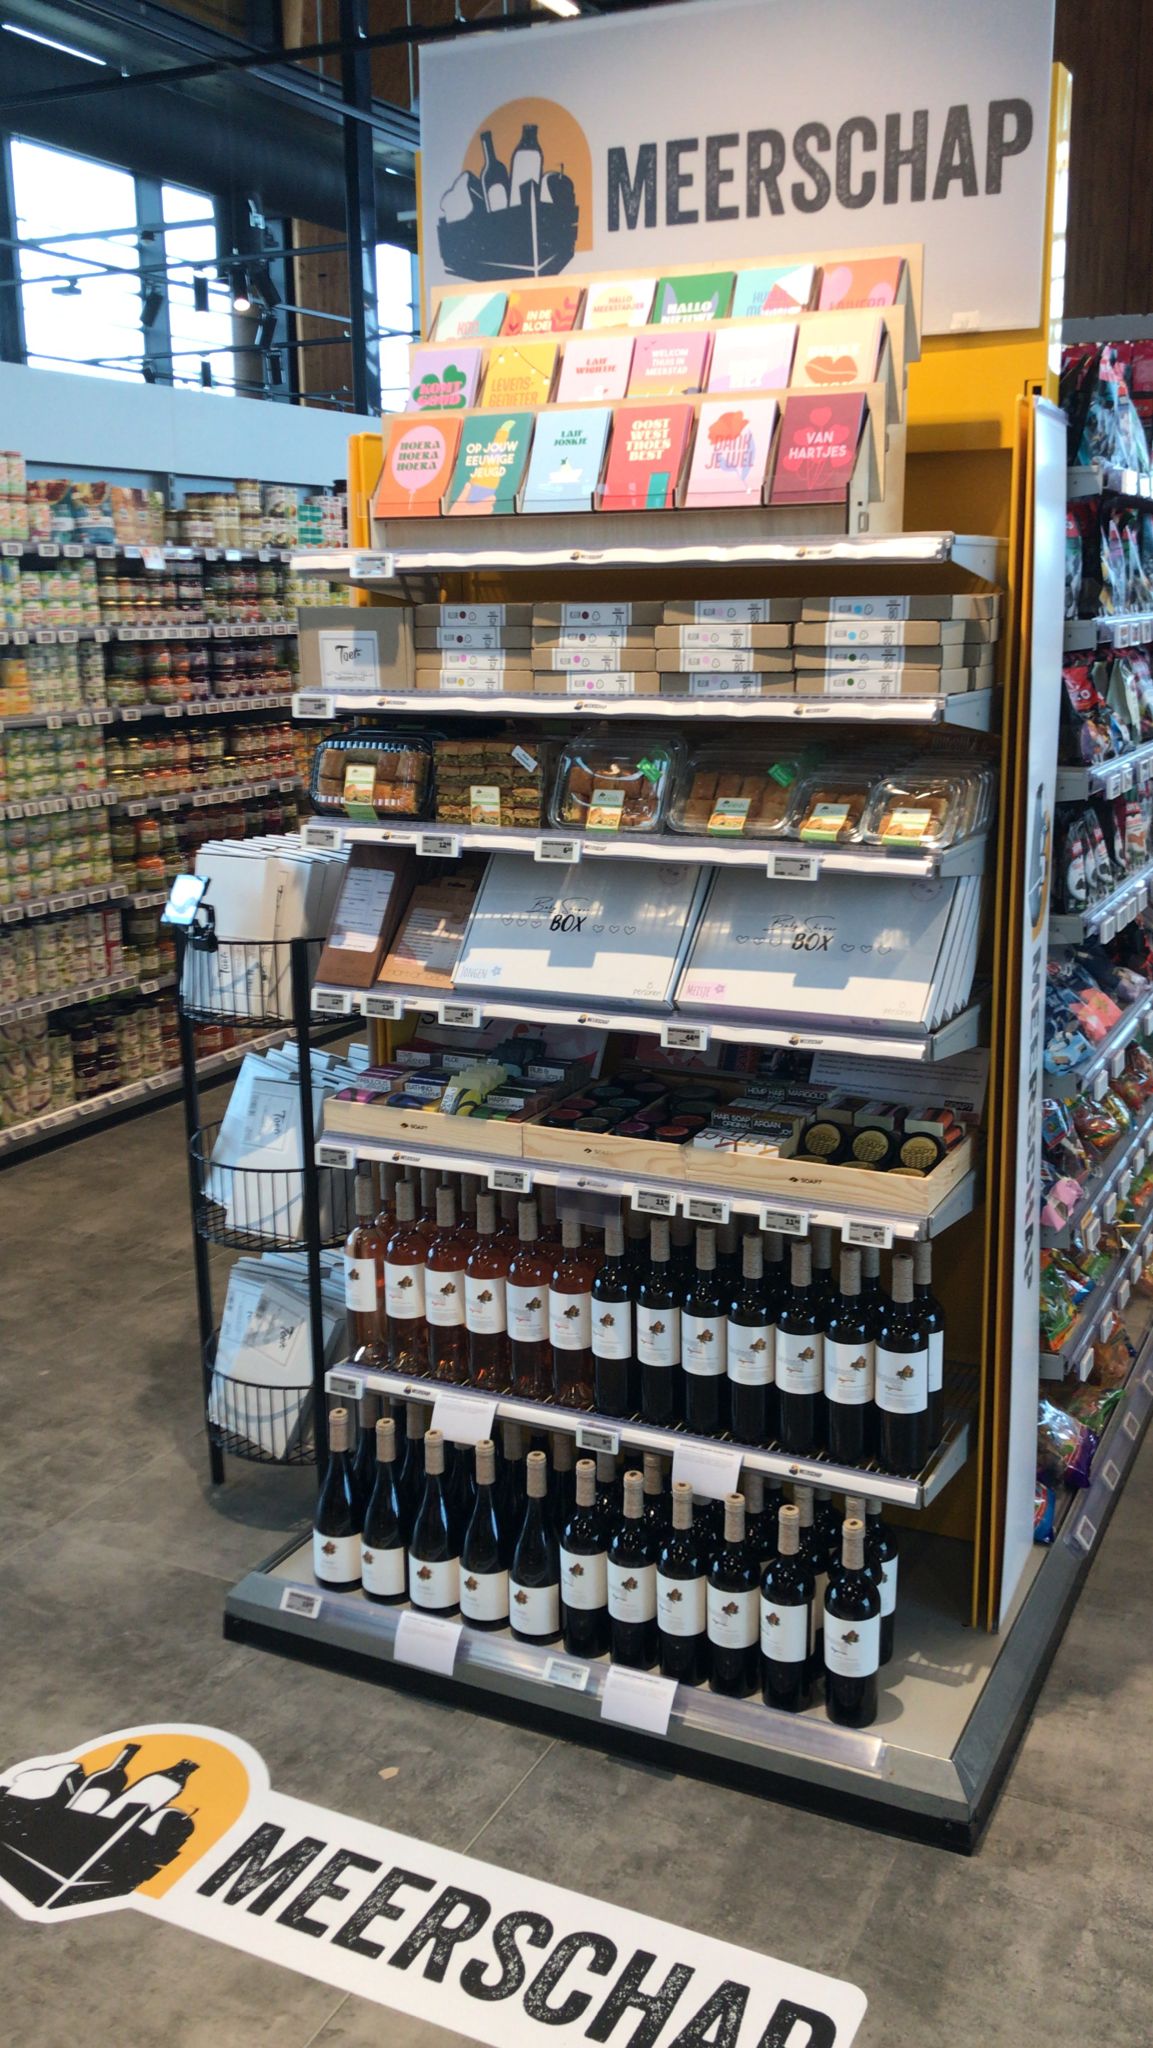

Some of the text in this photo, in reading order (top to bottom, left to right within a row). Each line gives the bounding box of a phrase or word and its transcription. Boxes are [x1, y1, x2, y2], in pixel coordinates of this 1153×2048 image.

[607, 98, 1033, 232] MEERSCHAP
[666, 300, 713, 315] HALLO
[526, 308, 553, 321] IN DE
[631, 418, 671, 430] OOST
[630, 428, 671, 441] WEST
[806, 431, 834, 445] VAN
[399, 440, 441, 451] HOERA
[465, 440, 519, 455] OP JOUW
[713, 433, 754, 452] DANK
[398, 450, 439, 461] HOERA
[629, 450, 664, 462] BEST
[788, 445, 848, 460] HARTJES
[465, 454, 515, 467] EEUWIGE
[704, 449, 755, 470] JE WEL
[396, 461, 437, 472] HOERA
[470, 466, 507, 479] JEUGD
[549, 914, 587, 932] BOX
[791, 932, 834, 952] BOX
[747, 1086, 785, 1097] HEMP HAIR
[787, 1089, 826, 1100] MARIGOLD
[713, 1112, 751, 1123] HAIR SOAP
[753, 1119, 782, 1129] ARGAN
[1022, 946, 1043, 1290] MEERSCHAP
[198, 1822, 838, 2048] MEERSCHAP
